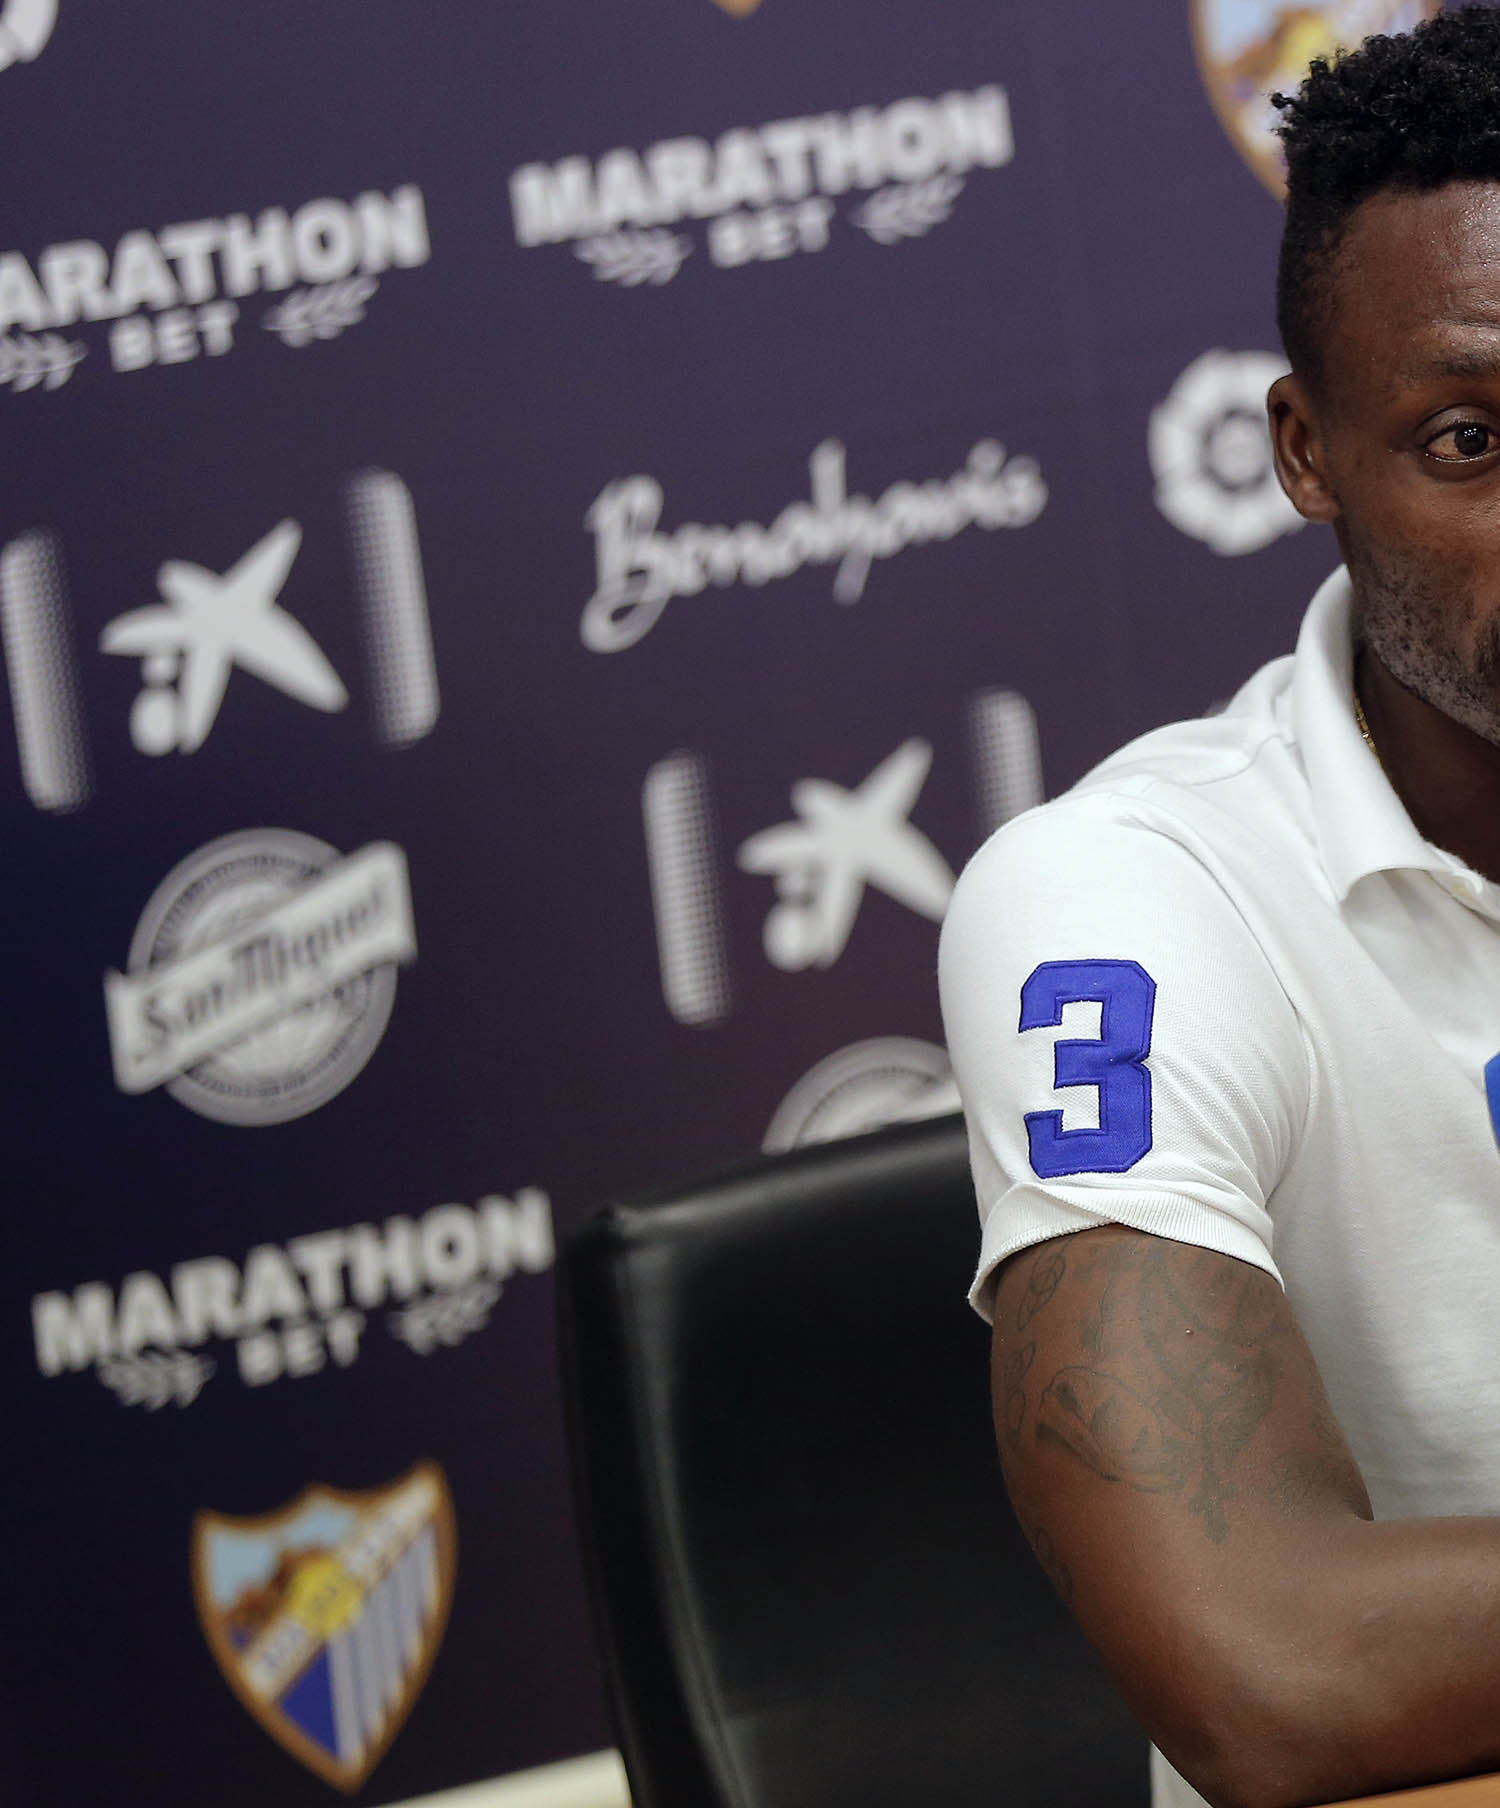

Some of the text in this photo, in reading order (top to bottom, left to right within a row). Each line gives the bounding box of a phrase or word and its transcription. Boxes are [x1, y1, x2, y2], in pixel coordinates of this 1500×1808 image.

[510, 84, 1014, 247] MARATHON
[709, 200, 833, 268] BET
[109, 301, 239, 372] BET
[1018, 958, 1156, 1179] 3
[32, 1187, 556, 1376] MARATHON
[236, 1309, 365, 1387] BET
